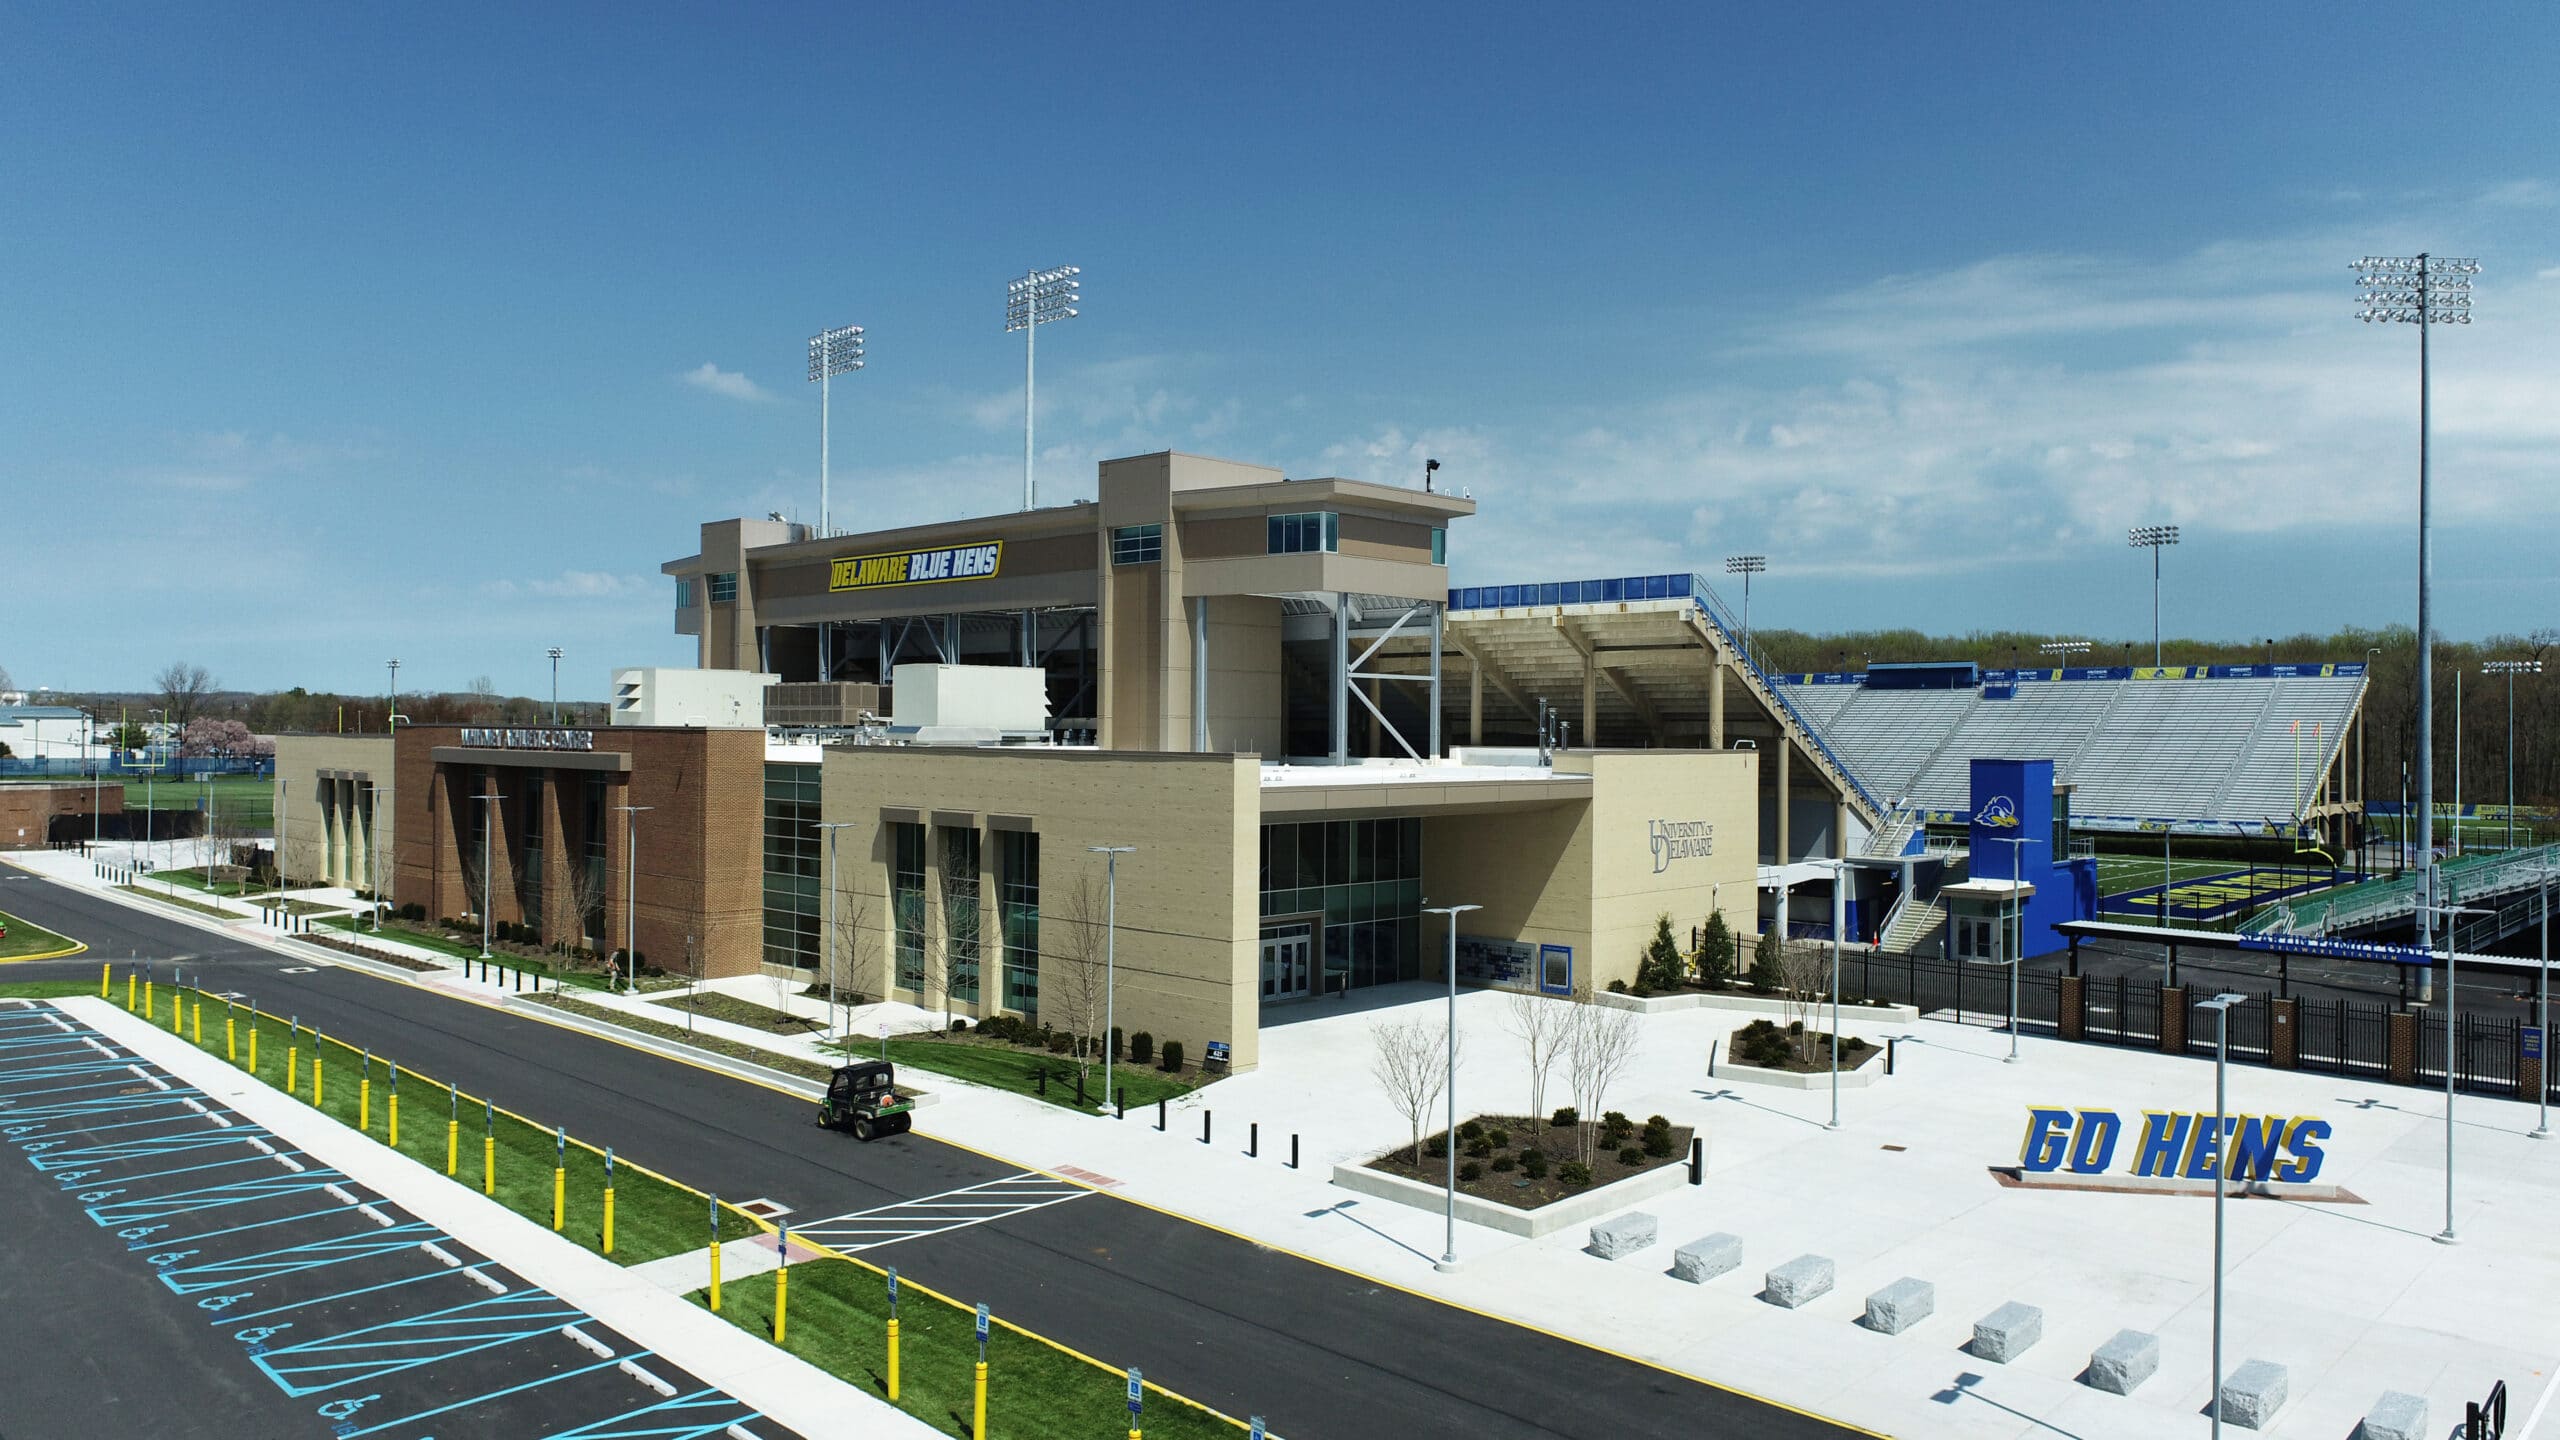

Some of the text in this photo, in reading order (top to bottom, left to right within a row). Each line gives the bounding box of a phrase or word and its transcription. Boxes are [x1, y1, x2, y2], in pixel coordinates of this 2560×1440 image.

[832, 545, 997, 588] DELAWARE BLUE HENS
[1648, 820, 1706, 854] UNIVERSITY
[1652, 835, 1713, 873] DELAWARE
[2269, 944, 2397, 961] DELAWARE STADIUM
[2019, 1105, 2333, 1184] GO HENS
